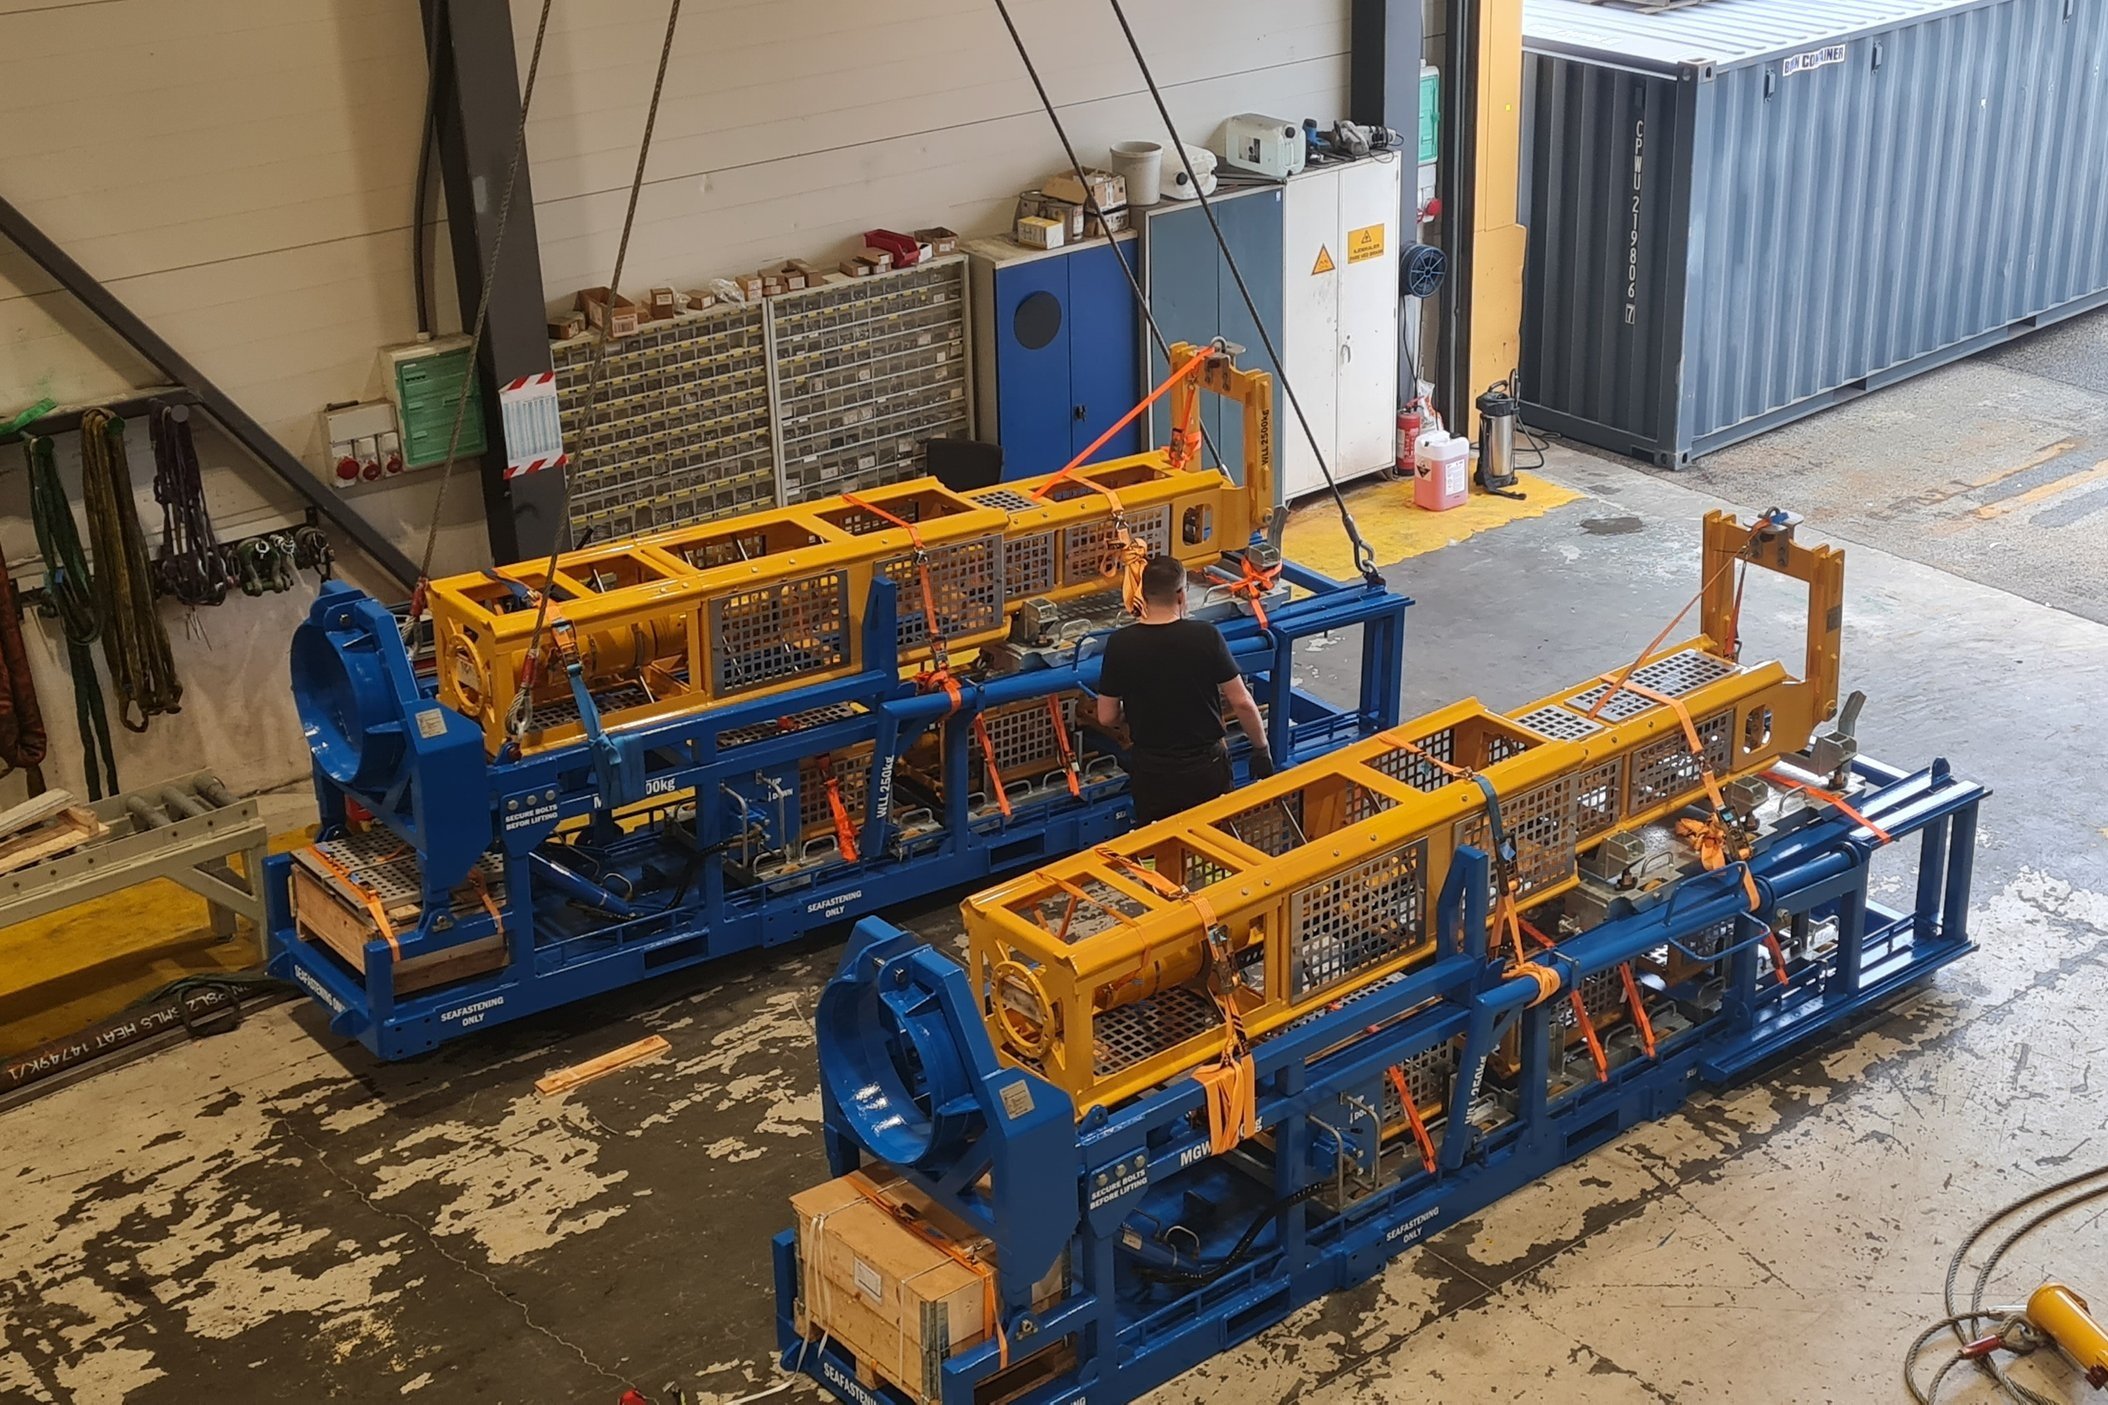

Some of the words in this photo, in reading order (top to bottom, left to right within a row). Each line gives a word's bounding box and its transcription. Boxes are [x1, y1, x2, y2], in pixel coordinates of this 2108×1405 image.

[1633, 120, 1644, 190] CPWU
[1627, 196, 1640, 298] 219806
[1625, 303, 1636, 324] 7
[880, 754, 895, 793] 250kg
[505, 810, 534, 823] SECURE
[535, 803, 558, 816] BOLTS
[876, 793, 889, 819] WLL
[506, 820, 530, 831] BEFOR
[531, 811, 559, 826] LIFTING
[807, 890, 862, 913] SEAFASTENING
[825, 905, 845, 918] ONLY
[440, 996, 504, 1022] SEAFASTENING
[462, 1013, 485, 1027] ONLY
[96, 1023, 137, 1049] HEAT
[1090, 1190, 1119, 1210] BEFORE
[1119, 1176, 1148, 1195] LIFTING
[1091, 1180, 1122, 1200] SECURE
[1123, 1168, 1146, 1185] BOLTS
[1386, 1206, 1440, 1242] SEAFASTENING
[1403, 1226, 1422, 1243] ONLY
